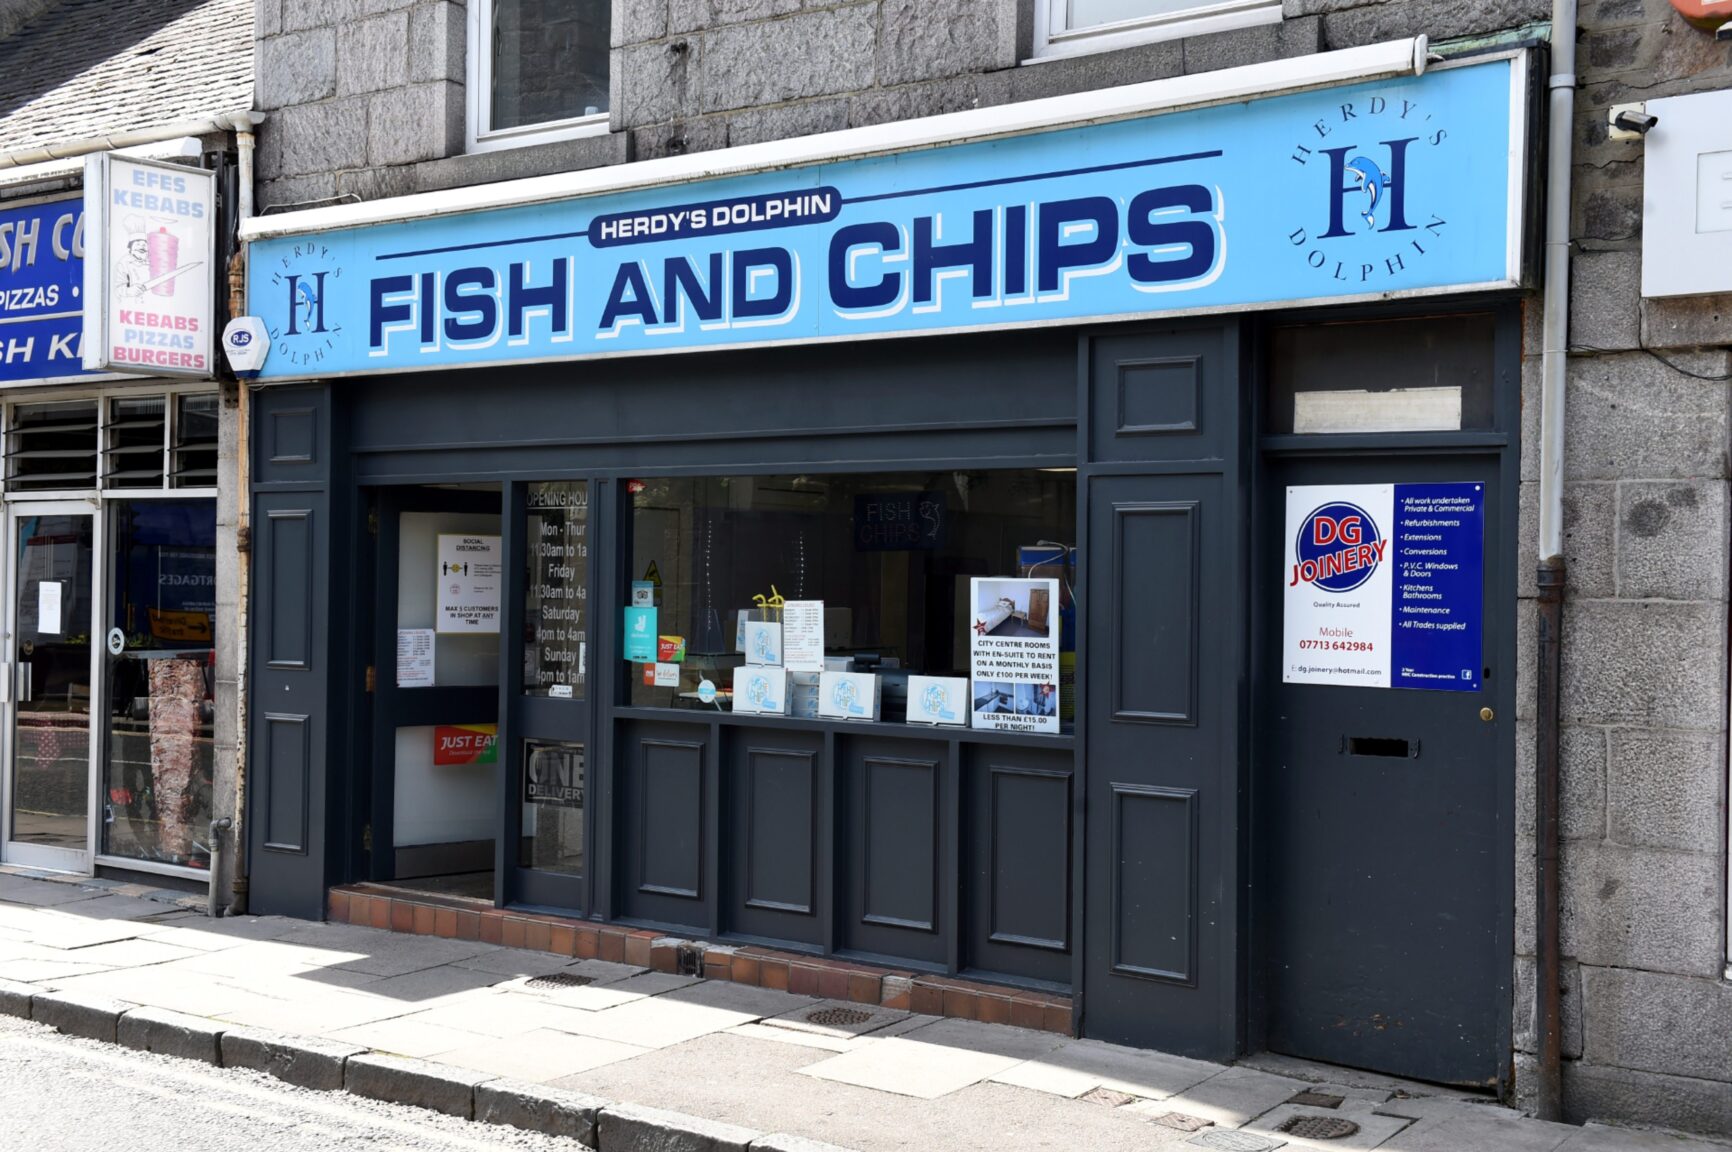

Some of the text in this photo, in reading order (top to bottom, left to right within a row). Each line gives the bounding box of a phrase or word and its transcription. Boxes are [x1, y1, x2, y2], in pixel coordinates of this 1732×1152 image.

[1291, 97, 1447, 165] HERDY'S
[133, 169, 186, 193] EFES
[113, 188, 204, 218] KEBABS
[601, 193, 831, 240] HERDY'S DOLPHIN
[1289, 214, 1447, 281] DOLPHIN
[272, 242, 342, 286] HERDY'S
[369, 184, 1227, 358] FISH AND CHIPS
[119, 309, 199, 332] KEBABS
[47, 332, 83, 360] K
[124, 329, 194, 349] PIZZAS
[232, 333, 250, 345] RJS
[271, 323, 342, 365] DOLPHIN
[113, 346, 205, 368] BURGERS
[527, 491, 566, 506] OPENING
[866, 501, 911, 522] FISH
[1434, 504, 1475, 512] Commercial
[540, 522, 557, 536] Mon
[565, 521, 586, 536] Thur
[1313, 516, 1362, 546] DG
[1404, 533, 1442, 541] Extensions
[565, 543, 575, 557] to
[1289, 538, 1388, 587] JOINERY
[1424, 562, 1458, 570] Windows
[548, 563, 575, 581] Friday
[565, 586, 574, 599] to
[1402, 584, 1433, 592] Kitchens
[1402, 592, 1442, 600] Bathrooms
[542, 605, 580, 623] Saturday
[1402, 606, 1450, 614] Maintenance
[556, 627, 566, 640] to
[567, 626, 586, 641] 4am
[1319, 627, 1353, 637] Mobile
[1413, 621, 1435, 629] Trades
[1436, 622, 1466, 631] supplied
[996, 640, 1022, 648] CENTRE
[1024, 641, 1051, 649] ROOMS
[1299, 640, 1373, 652] 07713 642984
[544, 647, 577, 665] Sunday
[992, 651, 1024, 659] EN-SUITE
[1037, 652, 1056, 660] RENT
[996, 661, 1029, 669] MONTHLY
[1031, 662, 1053, 670] BASIS
[556, 670, 565, 682] to
[567, 669, 585, 684] 1am
[983, 713, 1047, 724] LESS THAN £15.00
[995, 722, 1035, 731] PER NIGHT!
[440, 734, 499, 750] JUST EAT
